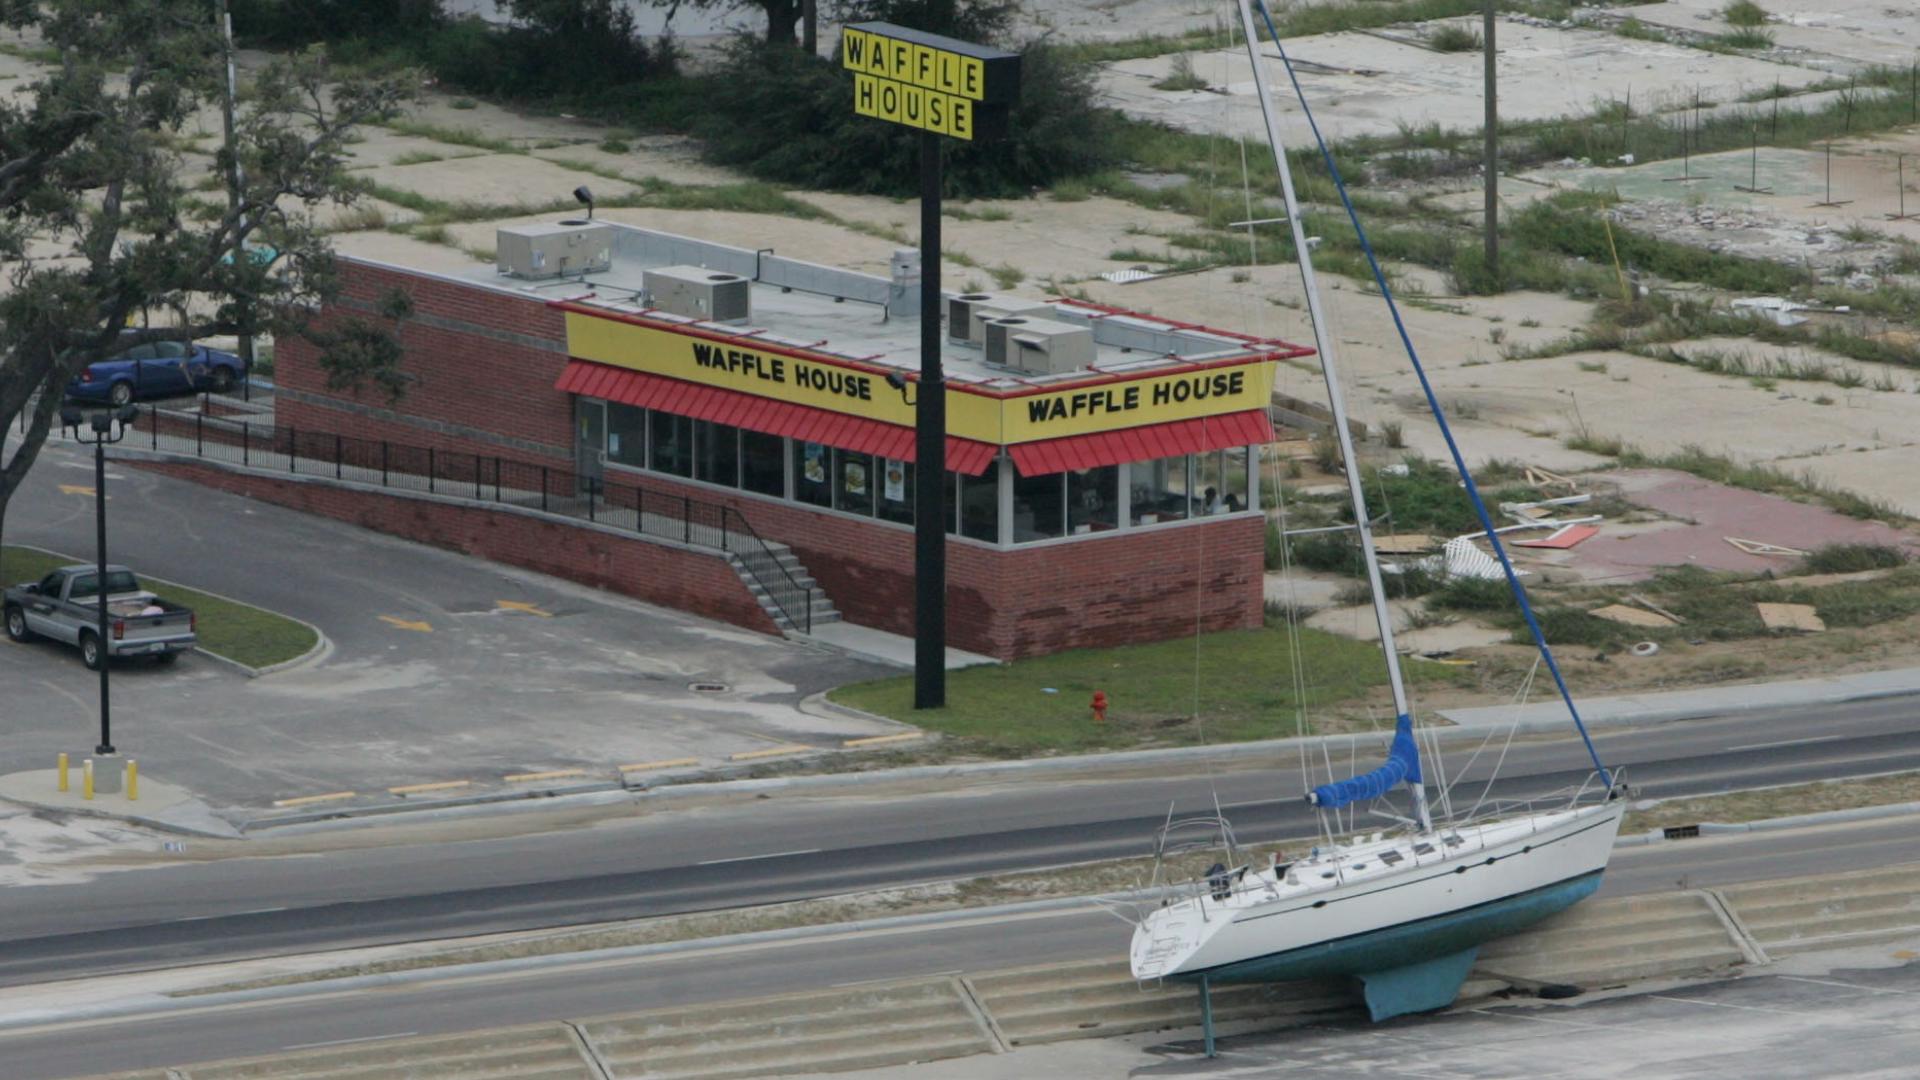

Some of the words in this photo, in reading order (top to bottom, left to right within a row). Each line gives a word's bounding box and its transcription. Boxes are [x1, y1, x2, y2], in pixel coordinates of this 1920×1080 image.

[846, 35, 977, 92] WAFFLE
[861, 80, 966, 132] HOUSE
[693, 343, 785, 383] WAFFLE
[795, 364, 871, 401] HOUSE
[1028, 386, 1139, 423] WAFFLE
[1153, 371, 1244, 406] HOUSE
